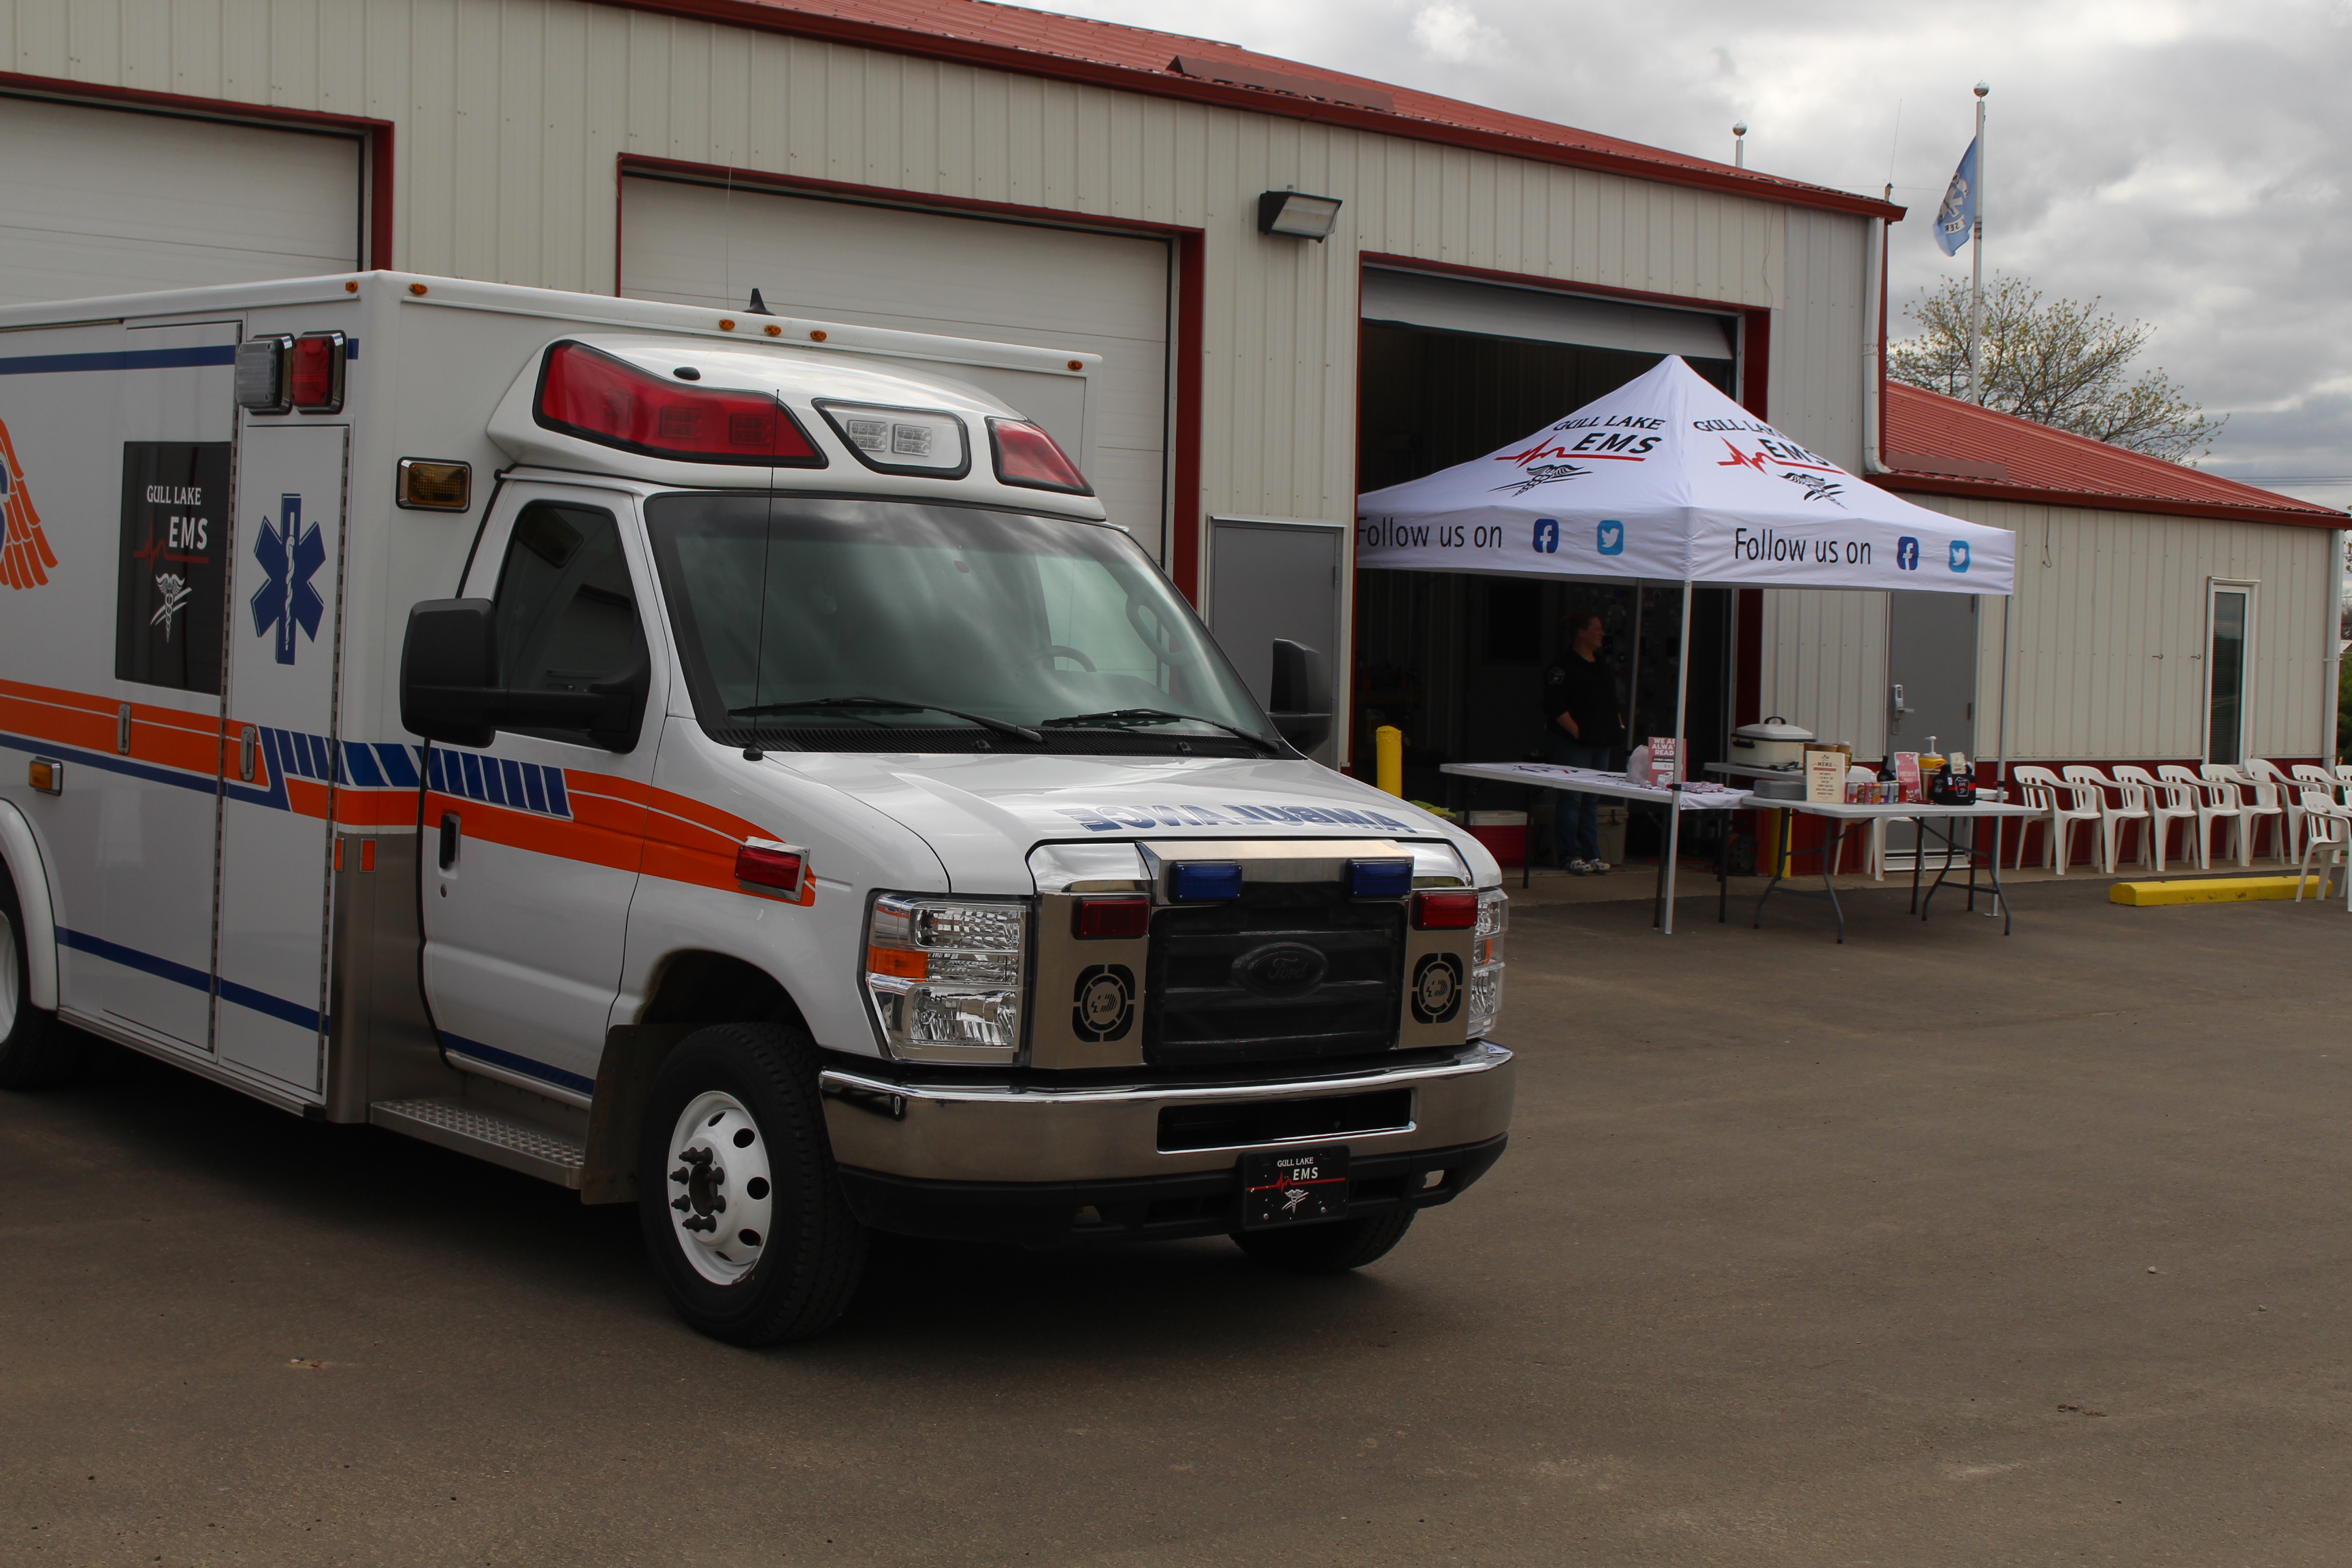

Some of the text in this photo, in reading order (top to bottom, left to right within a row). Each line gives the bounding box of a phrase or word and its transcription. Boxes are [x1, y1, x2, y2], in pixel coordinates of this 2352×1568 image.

[1553, 415, 1666, 431] GULL LAKE
[1693, 419, 1746, 431] GULL
[1571, 433, 1663, 454] EMS
[1757, 438, 1830, 466] EMS
[147, 485, 201, 505] GULL LAKE
[169, 516, 208, 549] EMS
[1357, 517, 1502, 548] Follow us on
[1735, 527, 1871, 564] Follow us on
[1268, 958, 1308, 980] Ford
[1277, 1157, 1313, 1167] GULL LAKE
[1293, 1166, 1318, 1181] EMS
